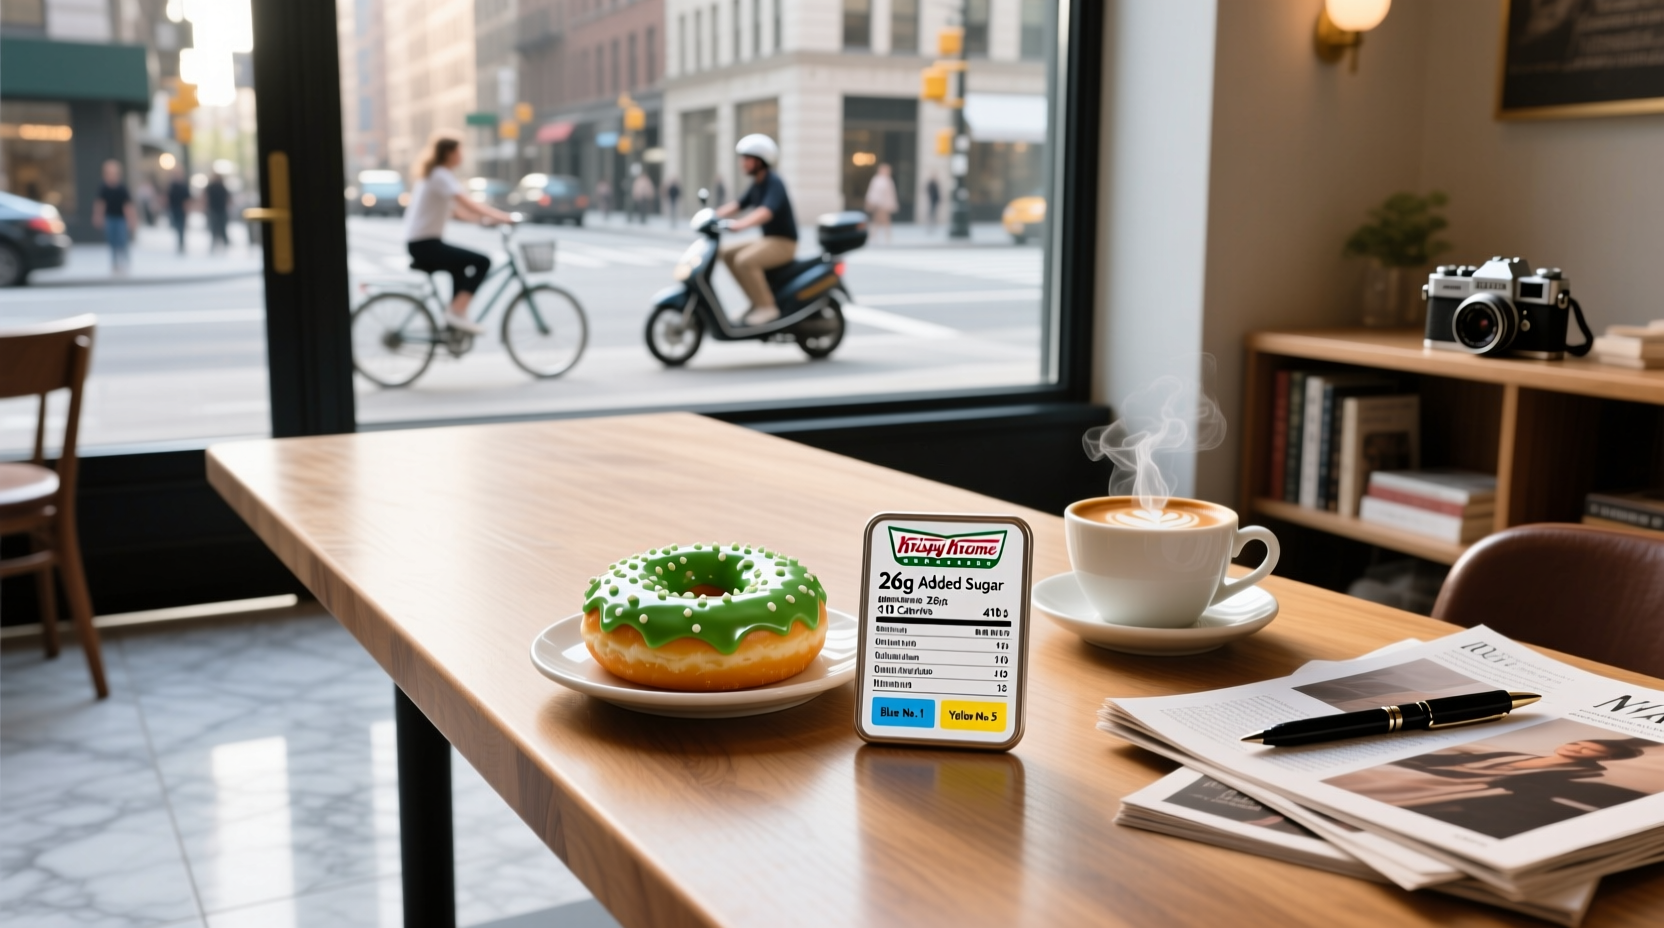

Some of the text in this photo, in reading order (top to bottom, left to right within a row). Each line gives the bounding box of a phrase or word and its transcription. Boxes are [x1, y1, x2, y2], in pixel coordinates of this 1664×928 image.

[897, 535, 946, 557] Krispy
[878, 571, 1005, 594] 26g Added Sugar
[920, 708, 924, 718] 1
[991, 711, 997, 721] 5
